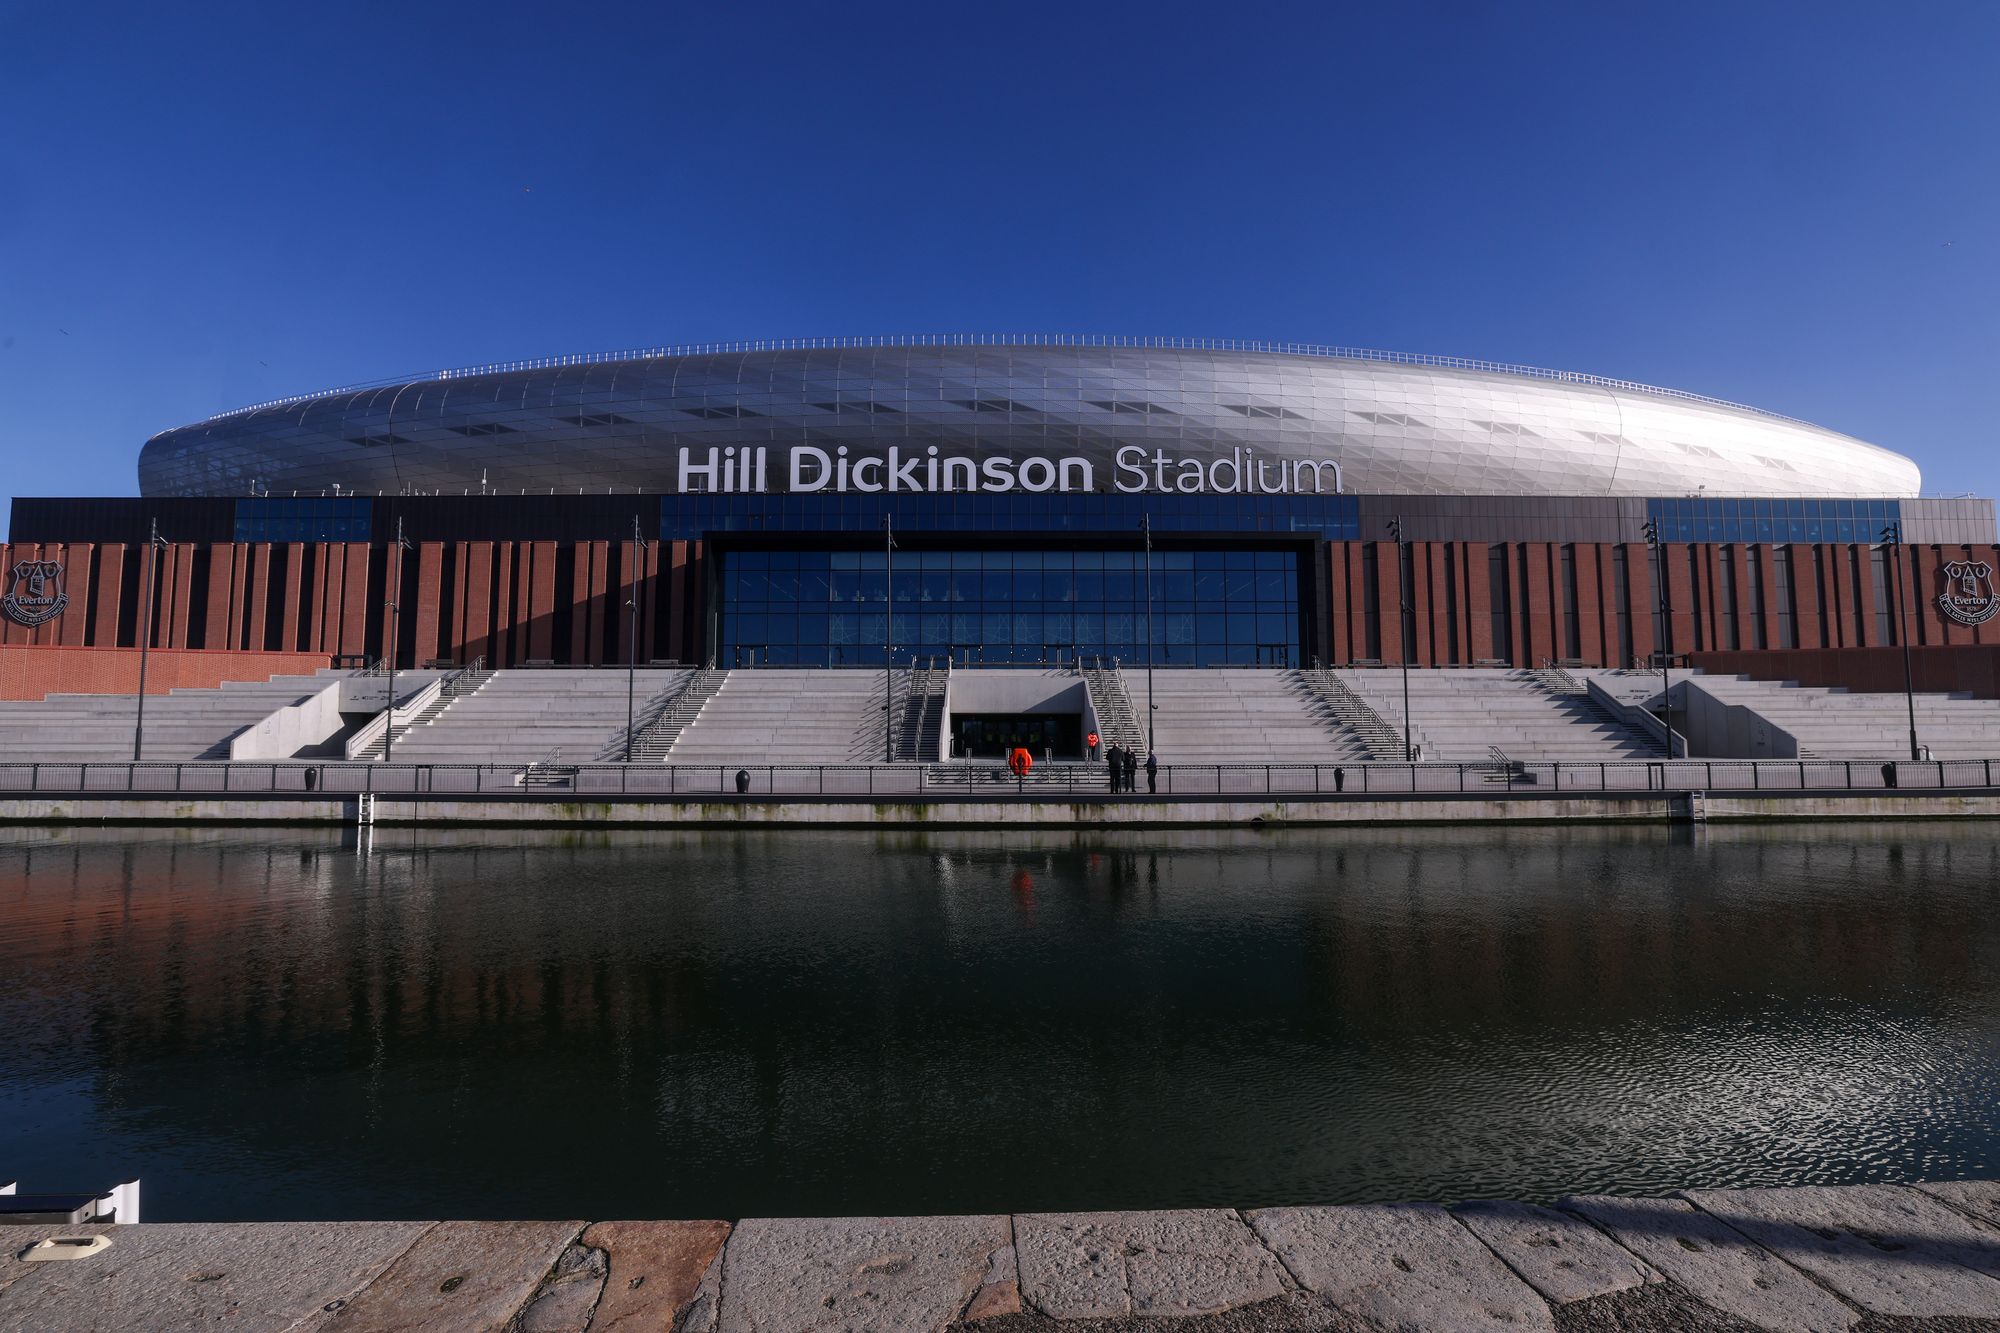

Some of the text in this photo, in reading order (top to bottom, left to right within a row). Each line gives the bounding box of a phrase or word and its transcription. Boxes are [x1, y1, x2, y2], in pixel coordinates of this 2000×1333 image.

[678, 445, 1342, 493] Hill Dickinson Stadium
[18, 595, 53, 605] Everton
[1954, 595, 1988, 605] Everton
[1952, 611, 1966, 622] SATIS
